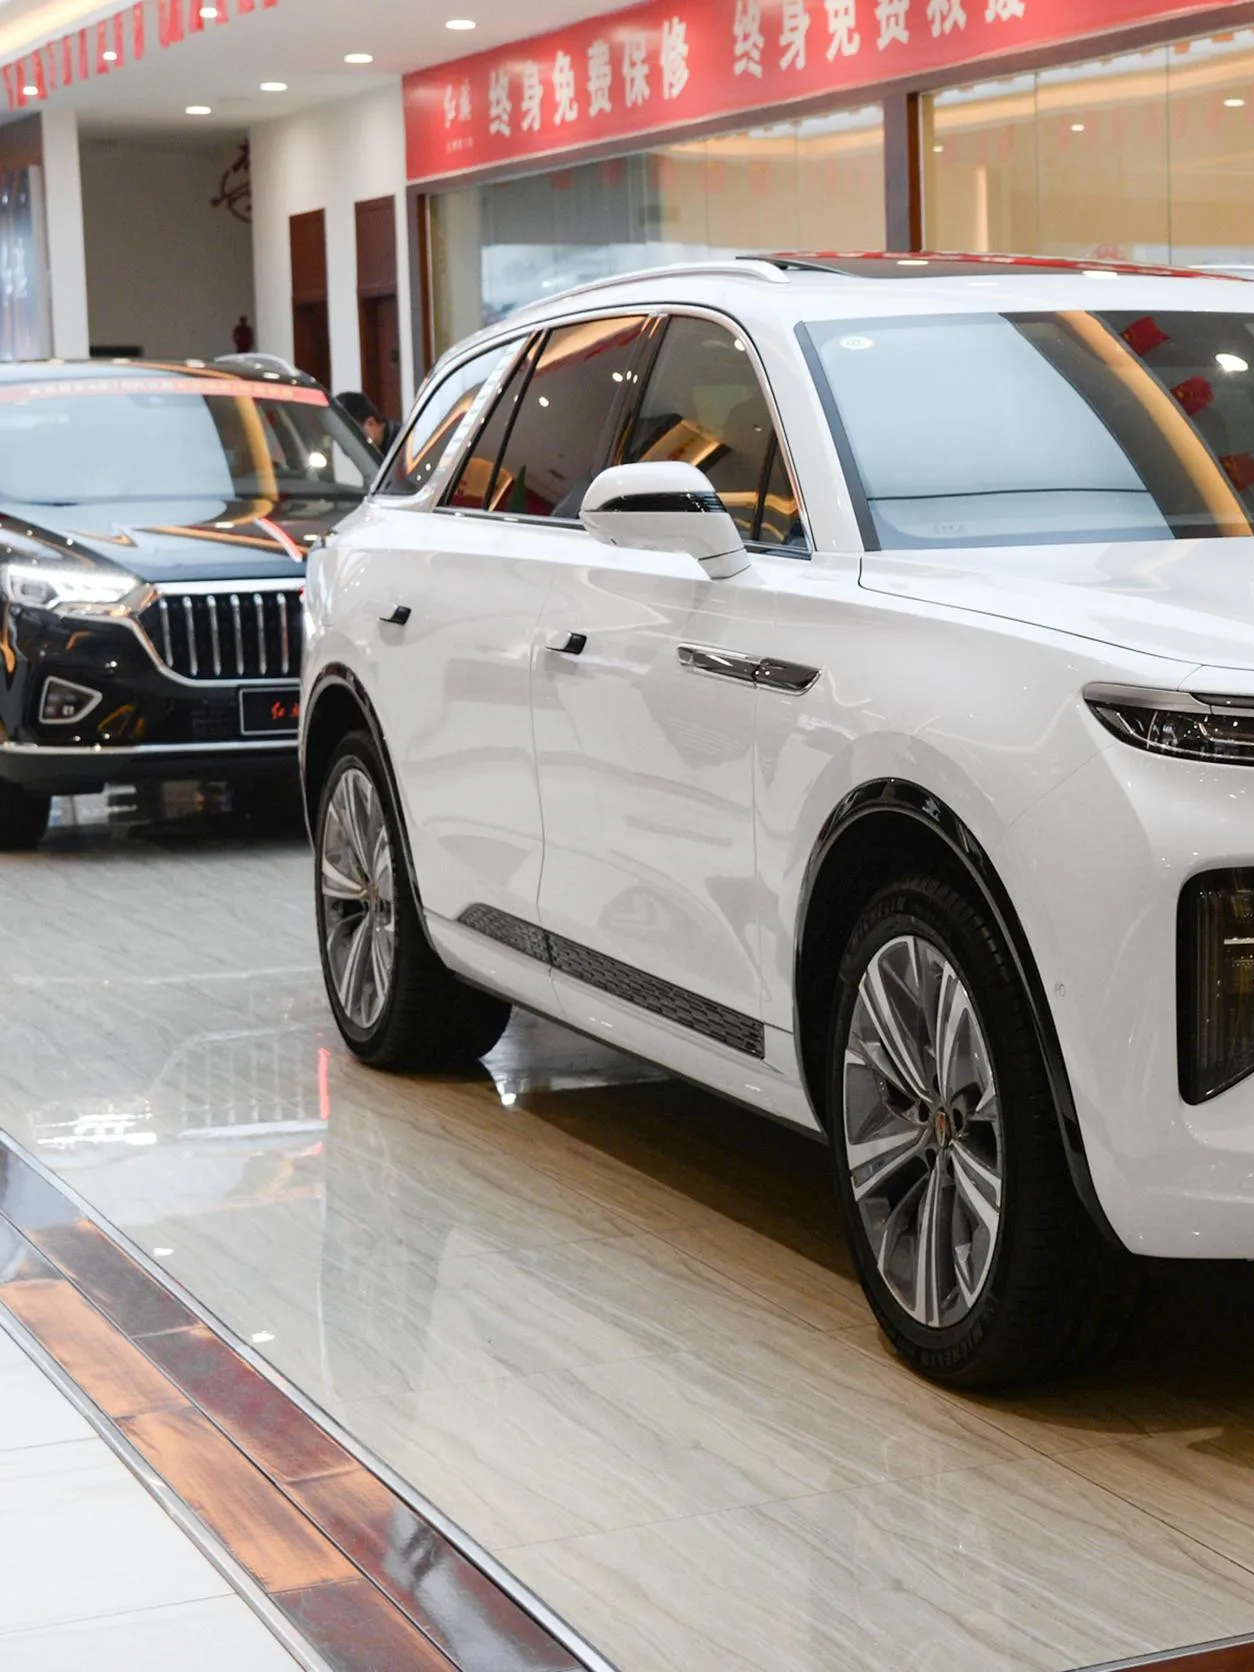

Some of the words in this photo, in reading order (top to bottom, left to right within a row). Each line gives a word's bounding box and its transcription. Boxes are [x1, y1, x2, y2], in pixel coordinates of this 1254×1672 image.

[488, 16, 690, 138] 终身免费保修
[732, 0, 1025, 78] 终身免费
